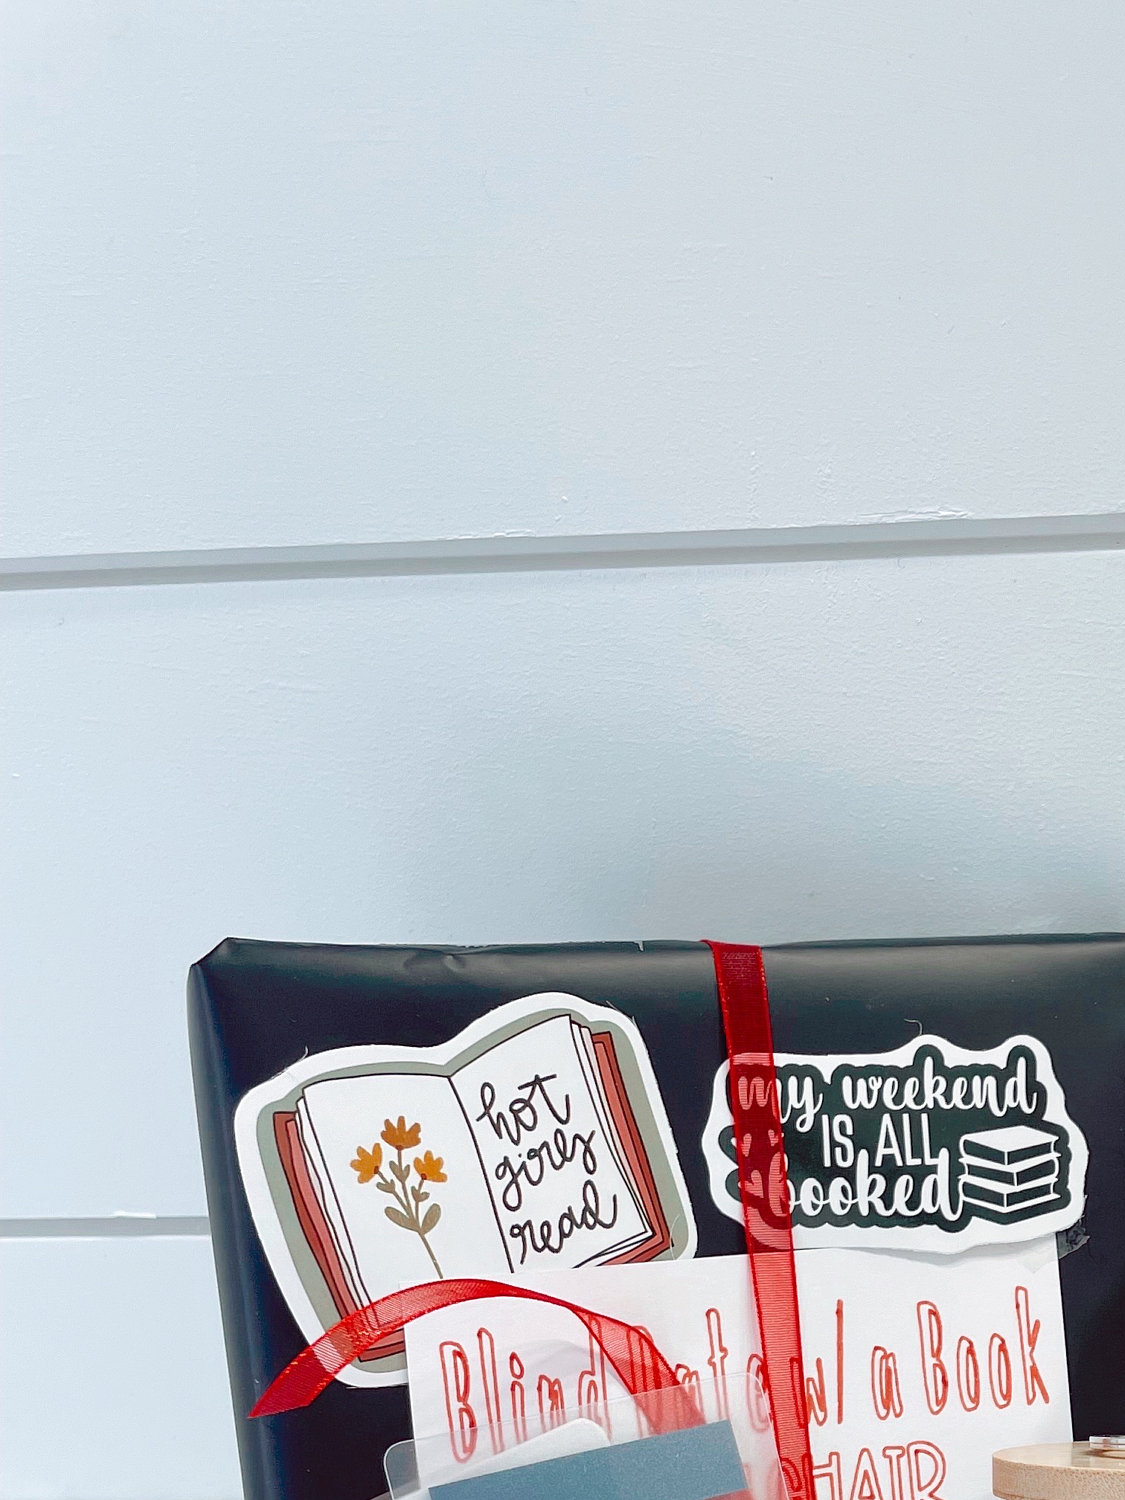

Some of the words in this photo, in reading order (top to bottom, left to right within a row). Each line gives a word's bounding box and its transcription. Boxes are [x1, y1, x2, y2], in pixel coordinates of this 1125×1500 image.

[476, 1074, 570, 1145] hot
[737, 1075, 822, 1133] my
[842, 1056, 1038, 1117] weekend
[496, 1129, 597, 1211] girls
[822, 1114, 855, 1168] IS
[875, 1113, 939, 1167] ALL
[509, 1179, 618, 1265] read
[769, 1147, 965, 1221] booked
[439, 1314, 613, 1463] Blind
[871, 1345, 904, 1422] a
[917, 1285, 1051, 1416] Book
